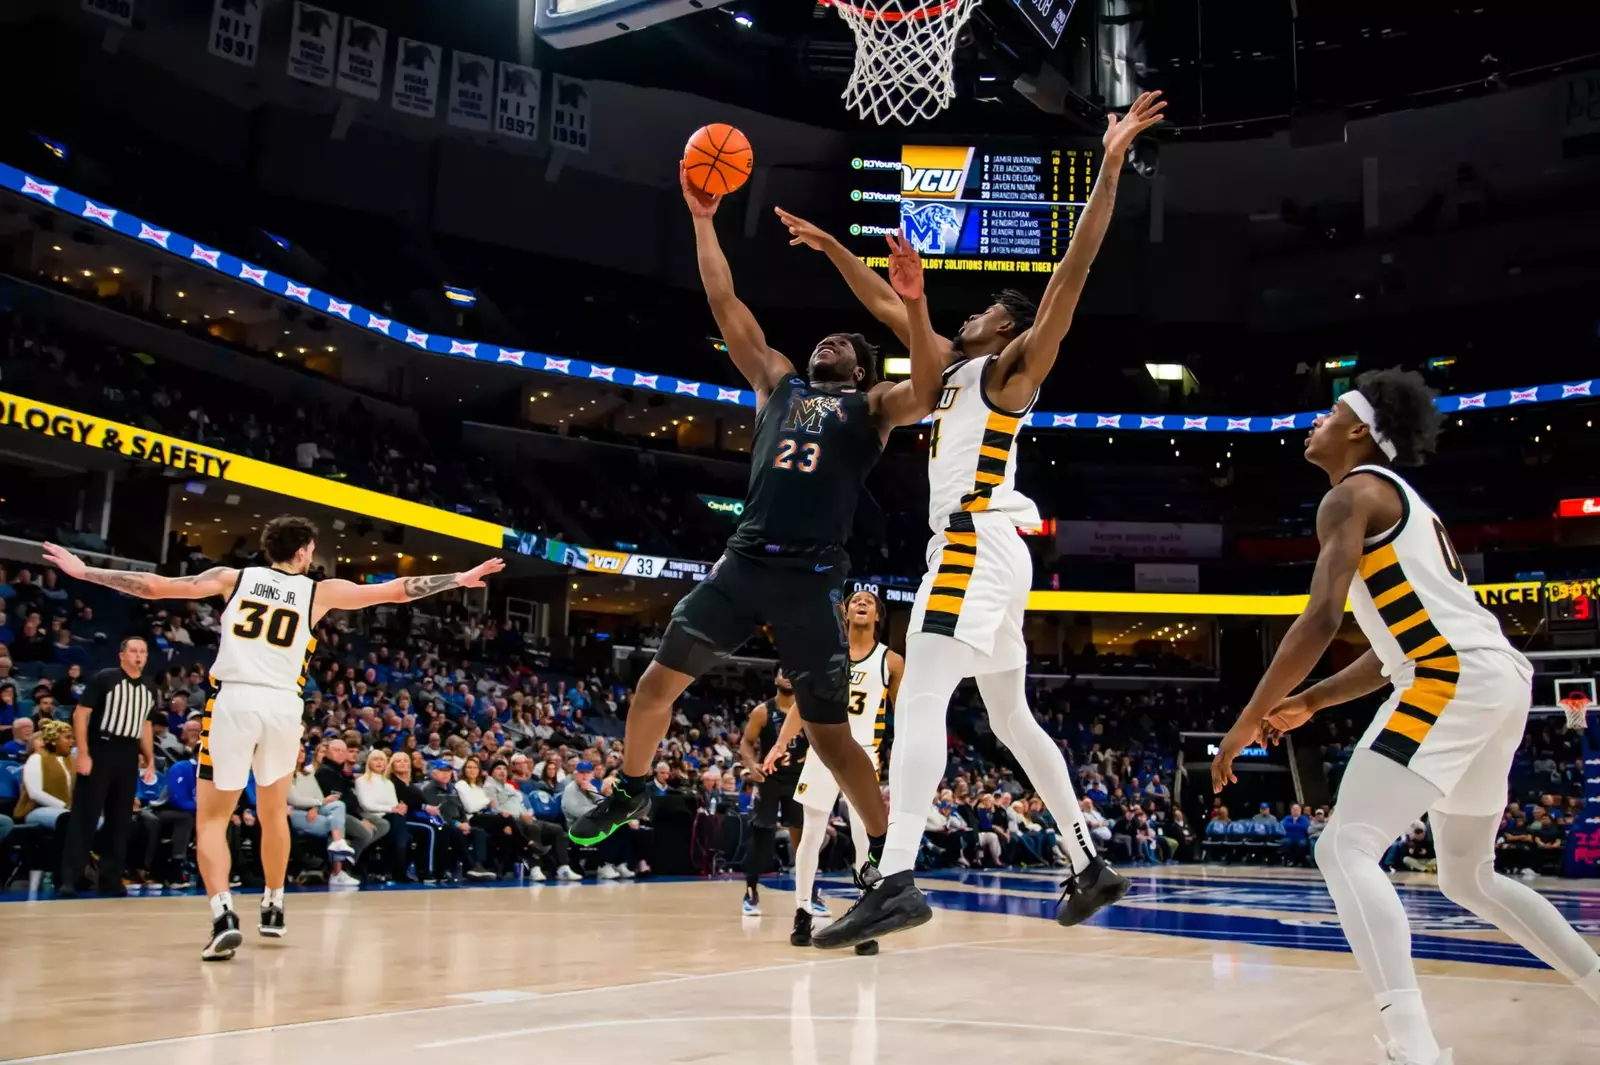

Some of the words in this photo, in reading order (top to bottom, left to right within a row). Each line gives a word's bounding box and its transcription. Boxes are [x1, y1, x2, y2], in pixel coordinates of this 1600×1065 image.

[215, 33, 253, 60] 1991
[498, 114, 535, 137] 1997
[901, 164, 963, 192] VCU
[944, 258, 983, 270] SOLUTIONS
[983, 260, 1015, 272] PARTNER
[1016, 261, 1030, 272] FOR
[1031, 262, 1052, 273] TIGER
[102, 428, 123, 451] &
[131, 435, 231, 479] SAFETY
[773, 438, 822, 473] 23
[593, 554, 621, 570] VCU
[637, 558, 653, 575] 33
[250, 582, 281, 601] JOHNS
[283, 593, 296, 606] JR.
[886, 589, 901, 601] 2ND
[901, 591, 917, 603] HAL
[1573, 596, 1589, 620] 3
[233, 598, 300, 648] 30
[848, 690, 868, 715] 3
